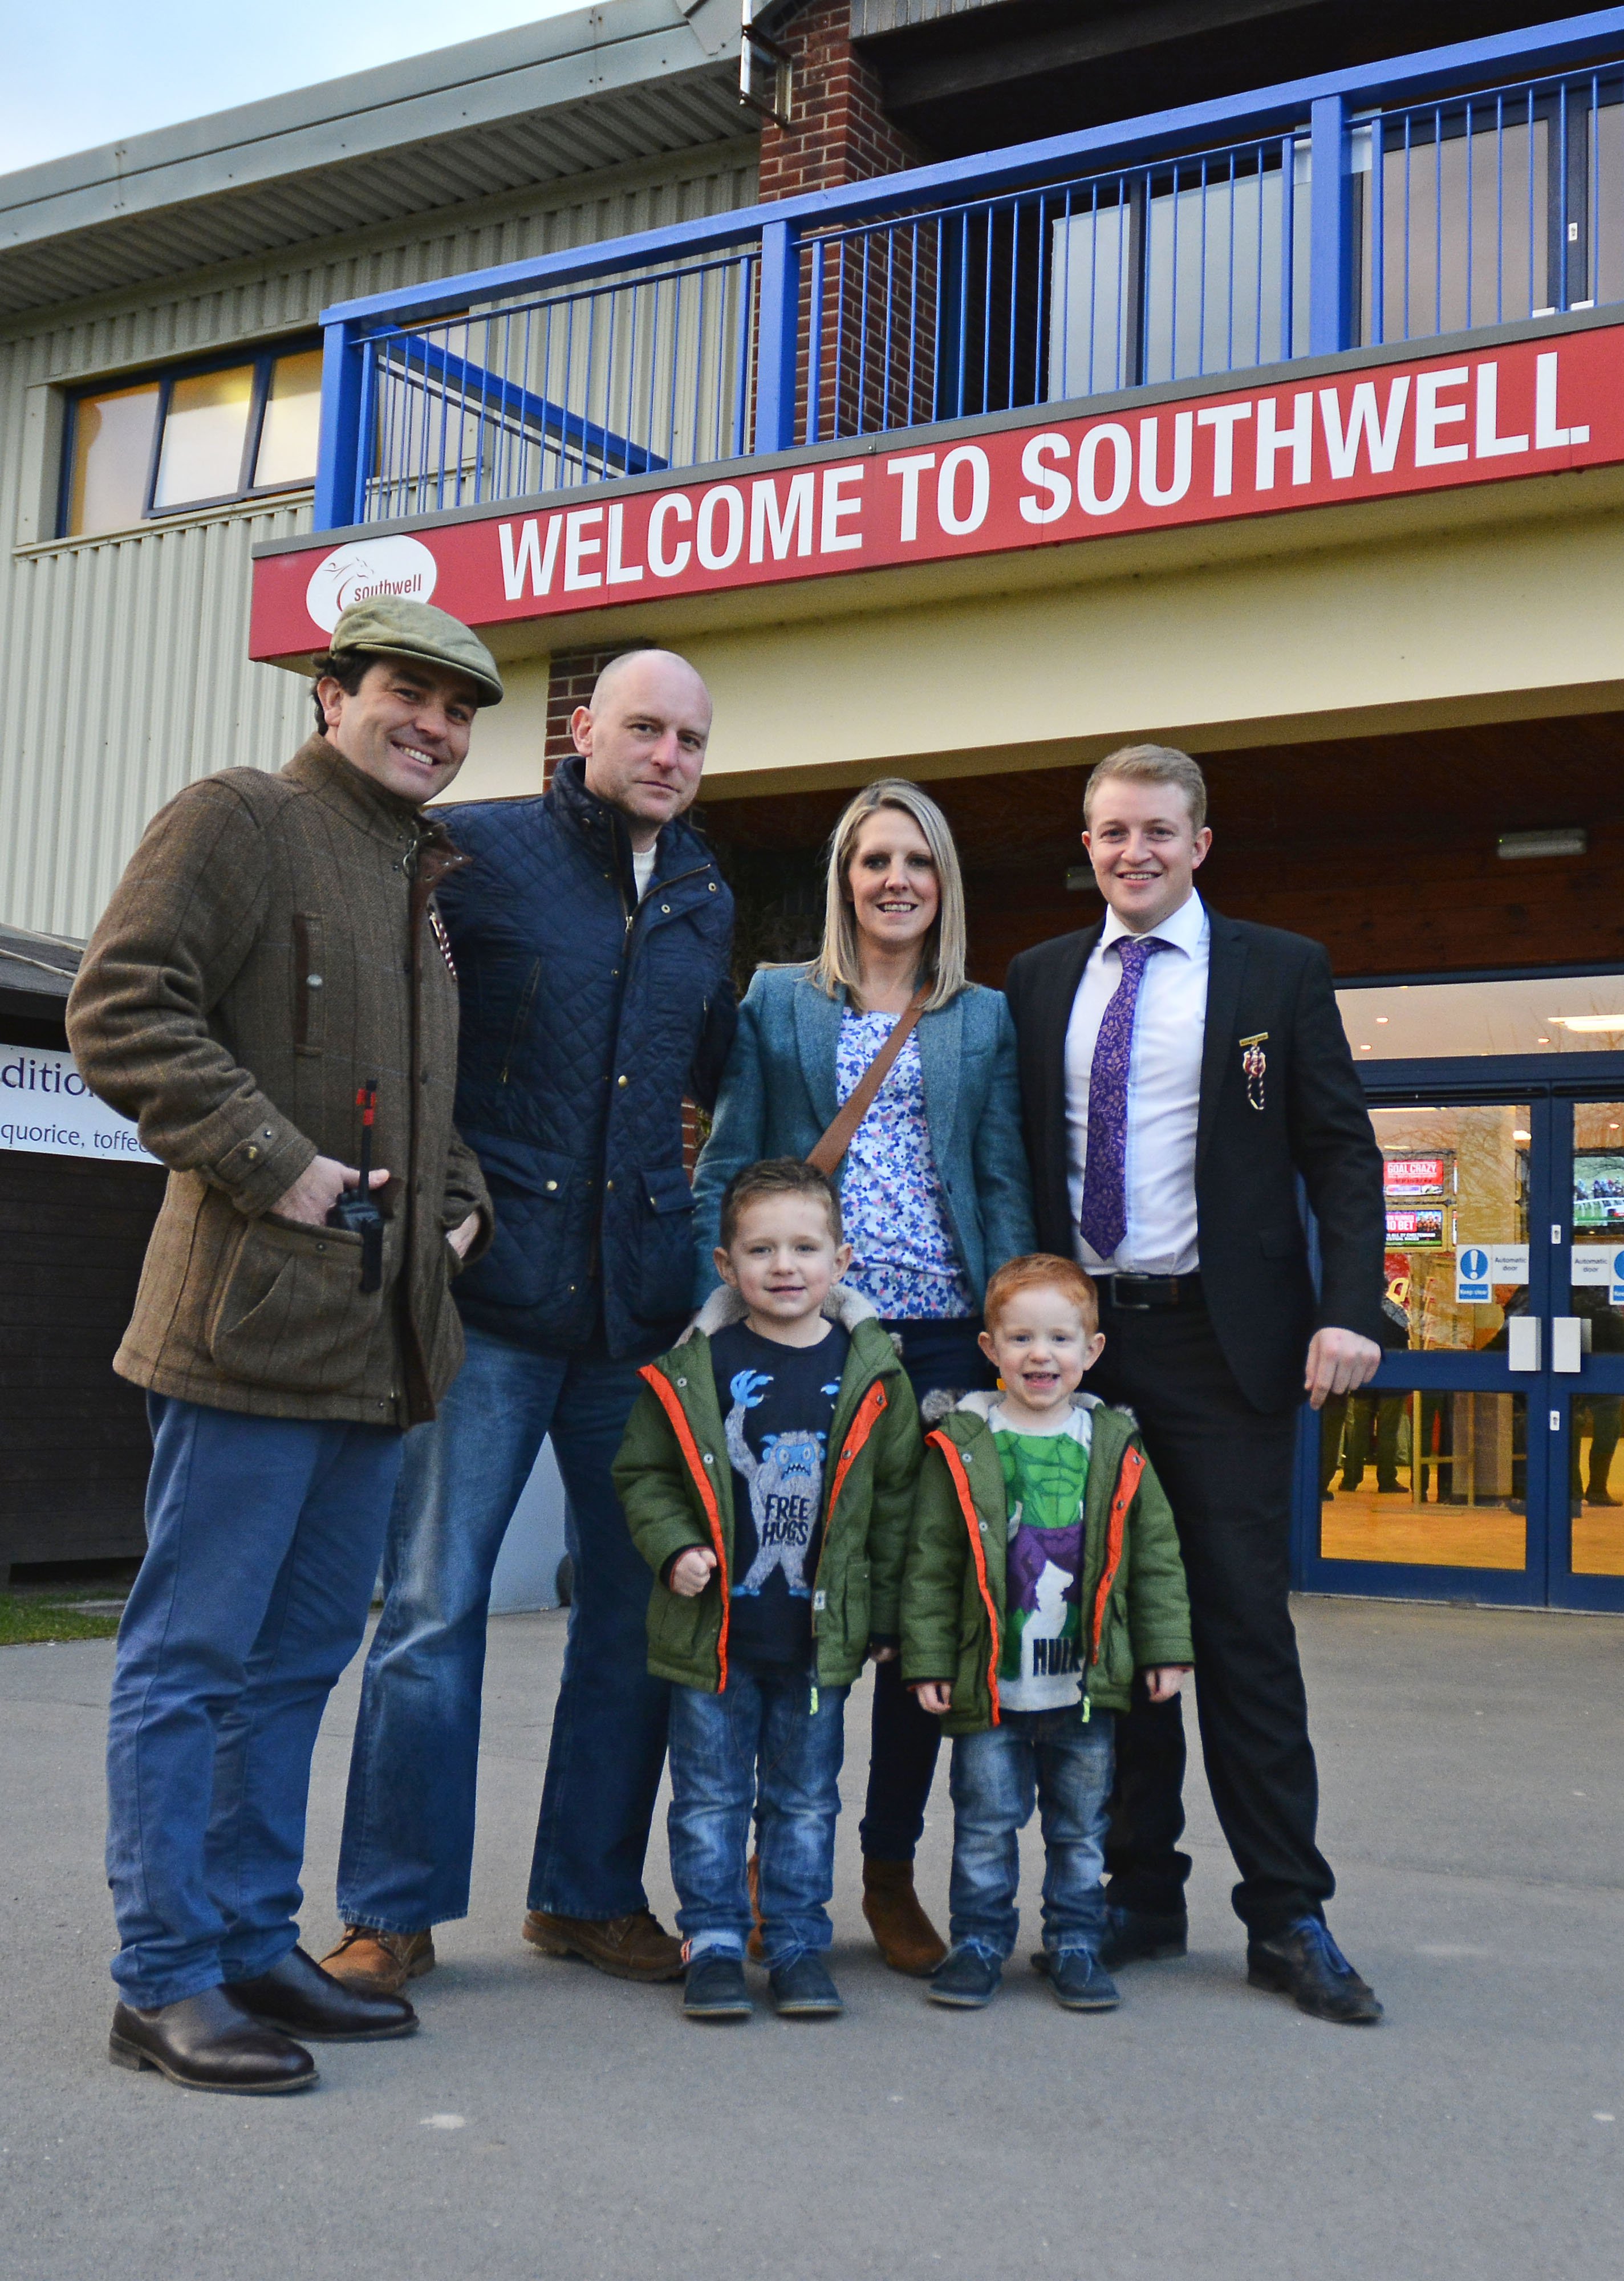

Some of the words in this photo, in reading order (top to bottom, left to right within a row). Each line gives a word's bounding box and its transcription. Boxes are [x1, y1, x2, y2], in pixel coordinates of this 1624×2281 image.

[498, 465, 864, 601] WELCOME
[887, 446, 990, 542] TO
[1019, 351, 1590, 524] SOUTHWELL
[354, 573, 421, 602] southwell
[1, 1057, 94, 1097] ditio
[1, 1123, 84, 1148] quorice,
[1387, 1163, 1409, 1174] GOAL
[1410, 1163, 1437, 1174] CRAZY
[1398, 1220, 1413, 1231] BET
[765, 1493, 810, 1521] FREE
[761, 1520, 809, 1547] HUGS
[1033, 1638, 1082, 1677] HULK
